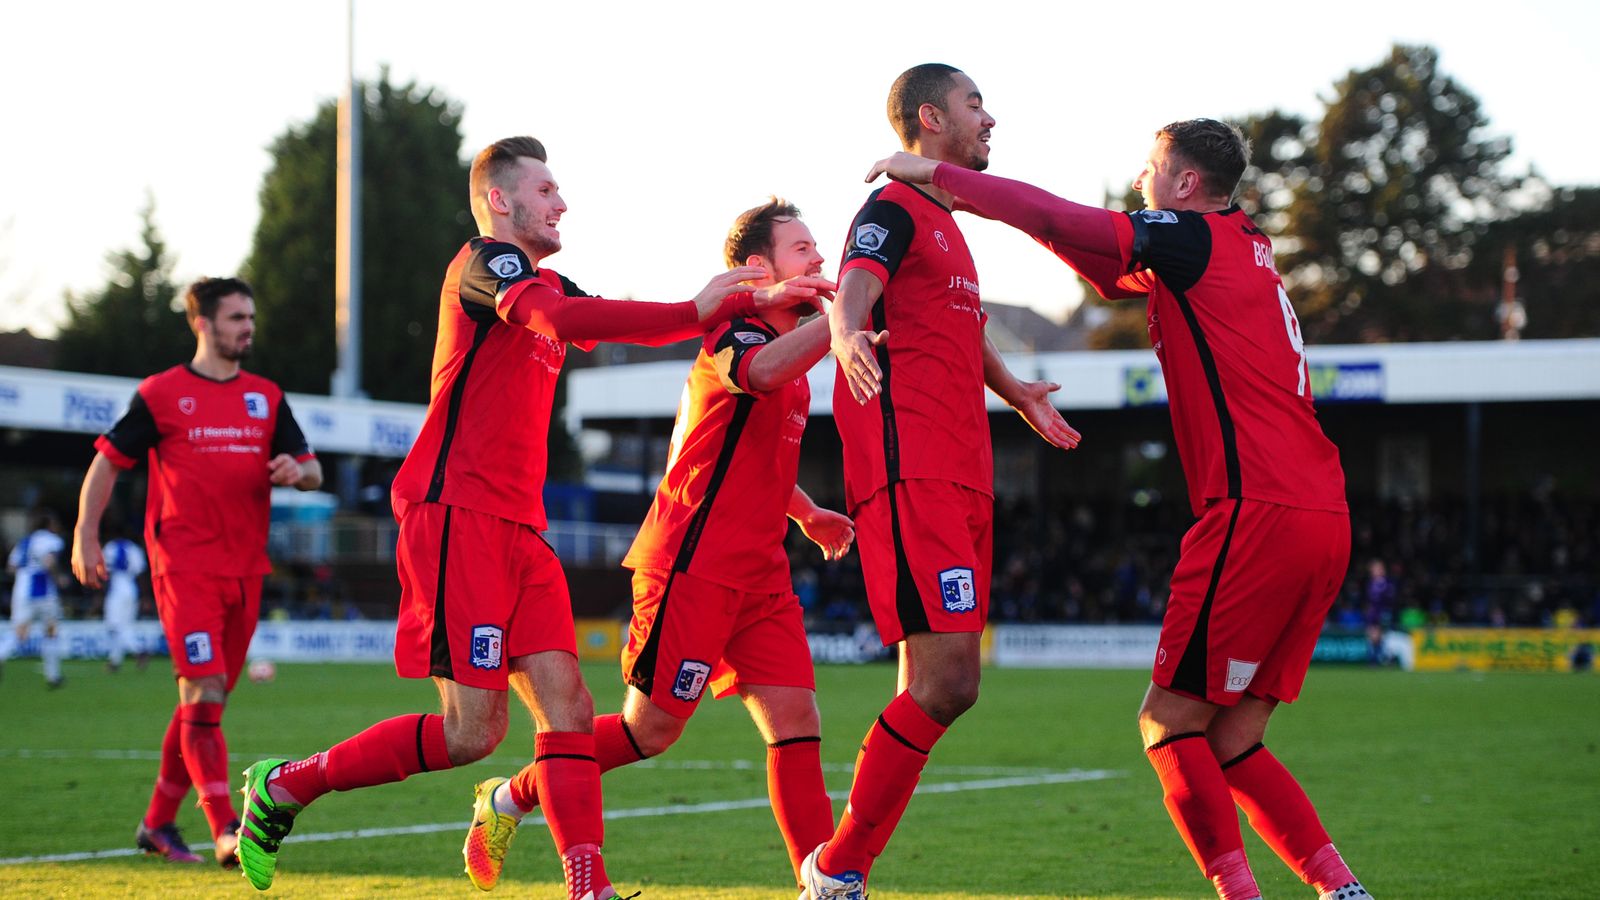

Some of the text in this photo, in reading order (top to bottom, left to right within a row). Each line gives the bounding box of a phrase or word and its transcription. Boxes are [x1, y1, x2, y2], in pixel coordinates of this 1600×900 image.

[948, 276, 954, 288] J
[956, 276, 962, 288] F
[1277, 284, 1306, 396] 9
[203, 426, 242, 439] Hornby
